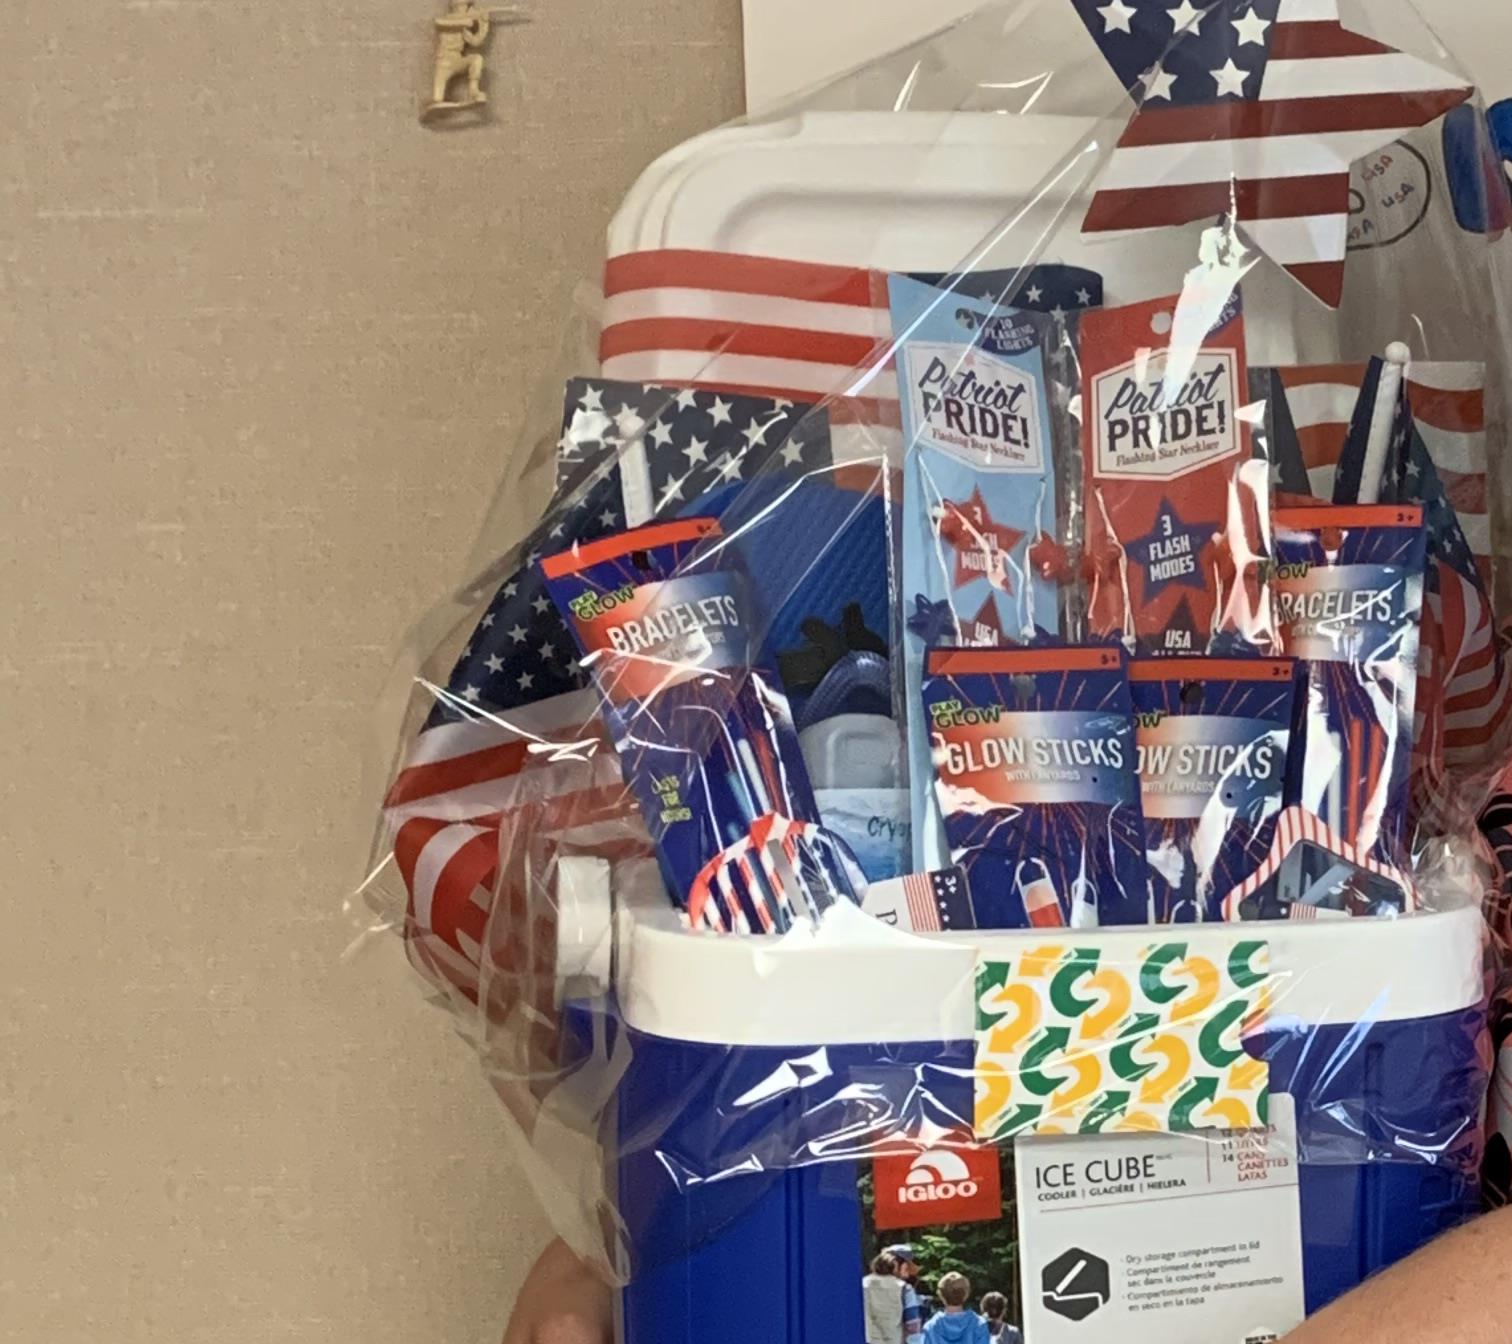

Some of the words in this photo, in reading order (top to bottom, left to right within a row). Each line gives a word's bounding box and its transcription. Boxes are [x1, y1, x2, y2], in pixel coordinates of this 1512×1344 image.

[918, 356, 1027, 414] Patriot
[1104, 362, 1226, 420] Patiot
[922, 390, 1031, 450] PRIDE!
[1107, 400, 1226, 452] PRIDE!
[1160, 514, 1172, 536] 3
[960, 550, 1002, 574] MODS
[1148, 534, 1192, 562] FLASH
[1149, 554, 1196, 583] MODES
[577, 587, 635, 621] GLOW
[606, 594, 739, 655] BRACELETS
[1164, 629, 1192, 649] USA
[932, 700, 960, 714] PLAY
[935, 706, 1001, 729] GLOW
[946, 736, 1026, 775] GLOW
[1032, 737, 1124, 770] STICKS
[1175, 744, 1273, 780] STICKS
[1035, 1163, 1076, 1189] ICE
[1085, 1154, 1156, 1184] CUBE
[1236, 1157, 1289, 1172] CANETTES
[1237, 1170, 1268, 1183] LATAS
[898, 1180, 978, 1204] IGLOO
[1038, 1189, 1077, 1202] COOLER
[1088, 1182, 1135, 1197] GLACIÈRE
[1146, 1178, 1187, 1191] HIELERA
